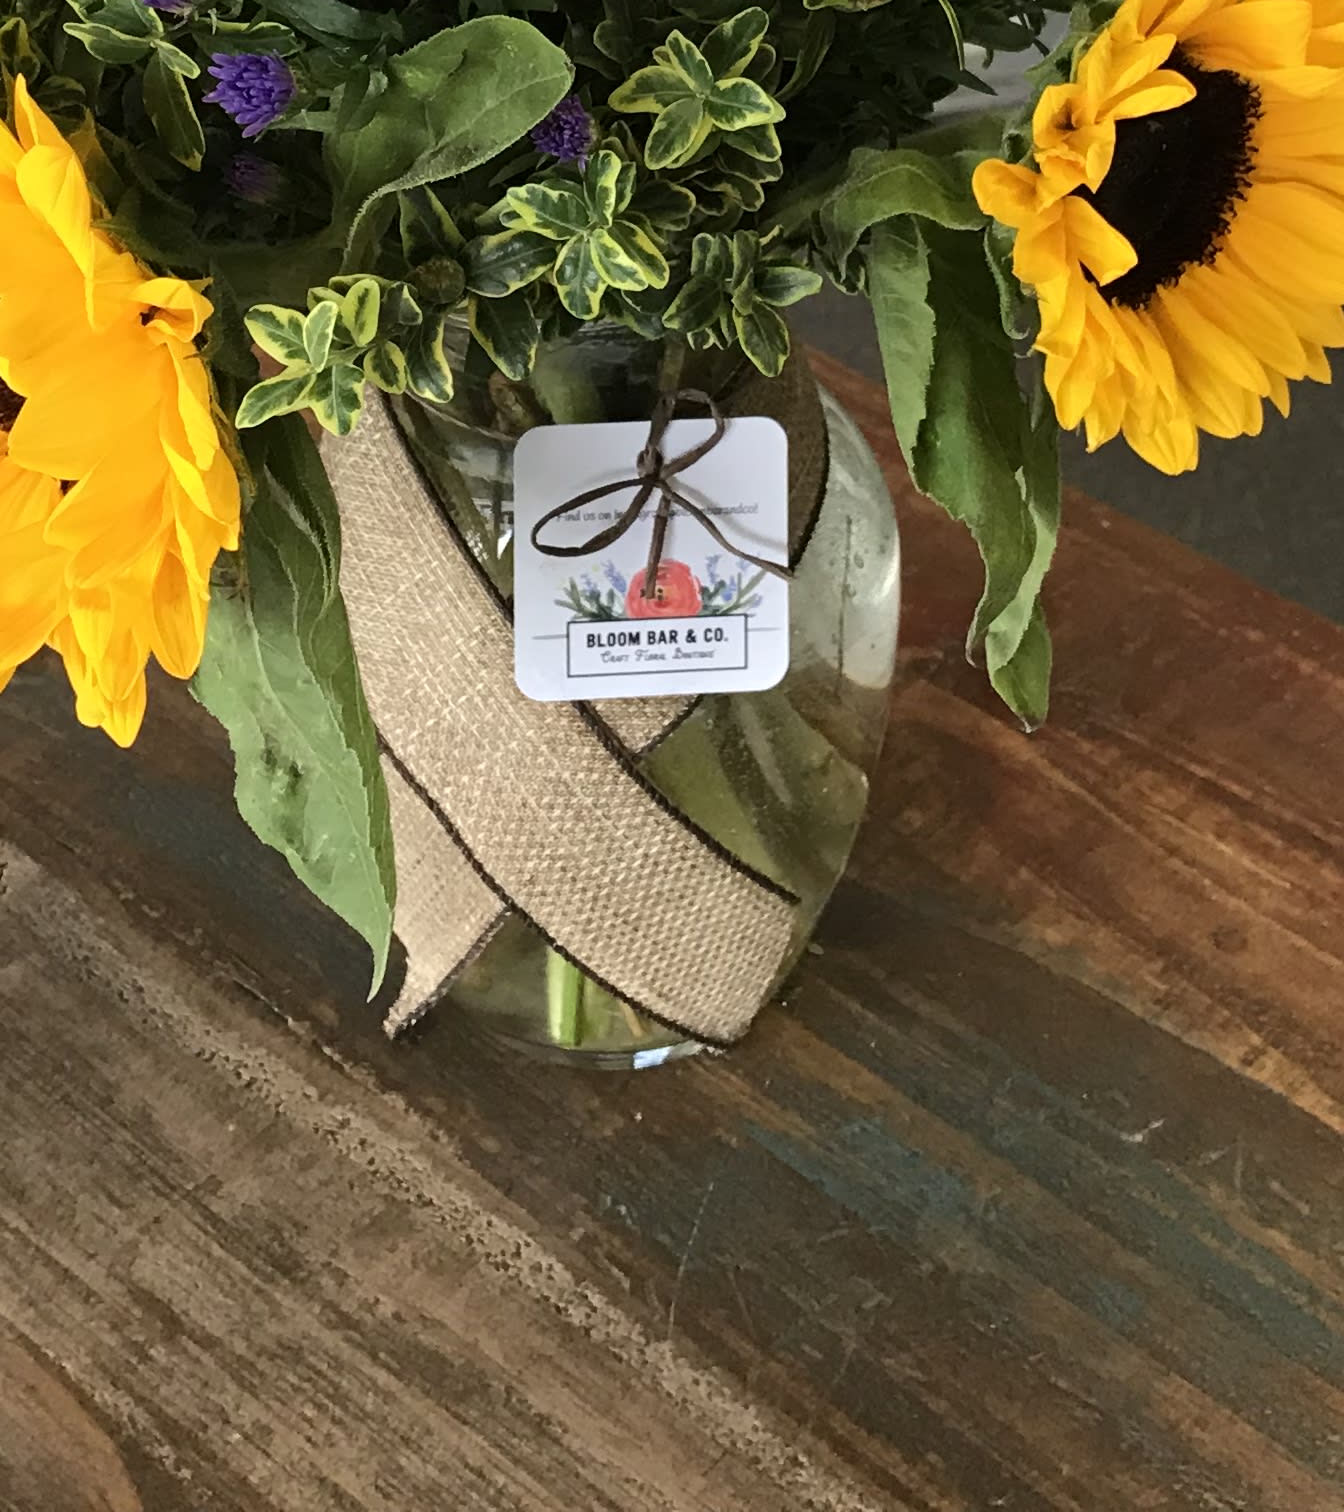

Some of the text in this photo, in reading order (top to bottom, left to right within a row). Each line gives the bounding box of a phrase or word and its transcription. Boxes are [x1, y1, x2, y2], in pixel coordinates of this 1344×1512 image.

[587, 627, 729, 648] BLOOM BAR & CO.
